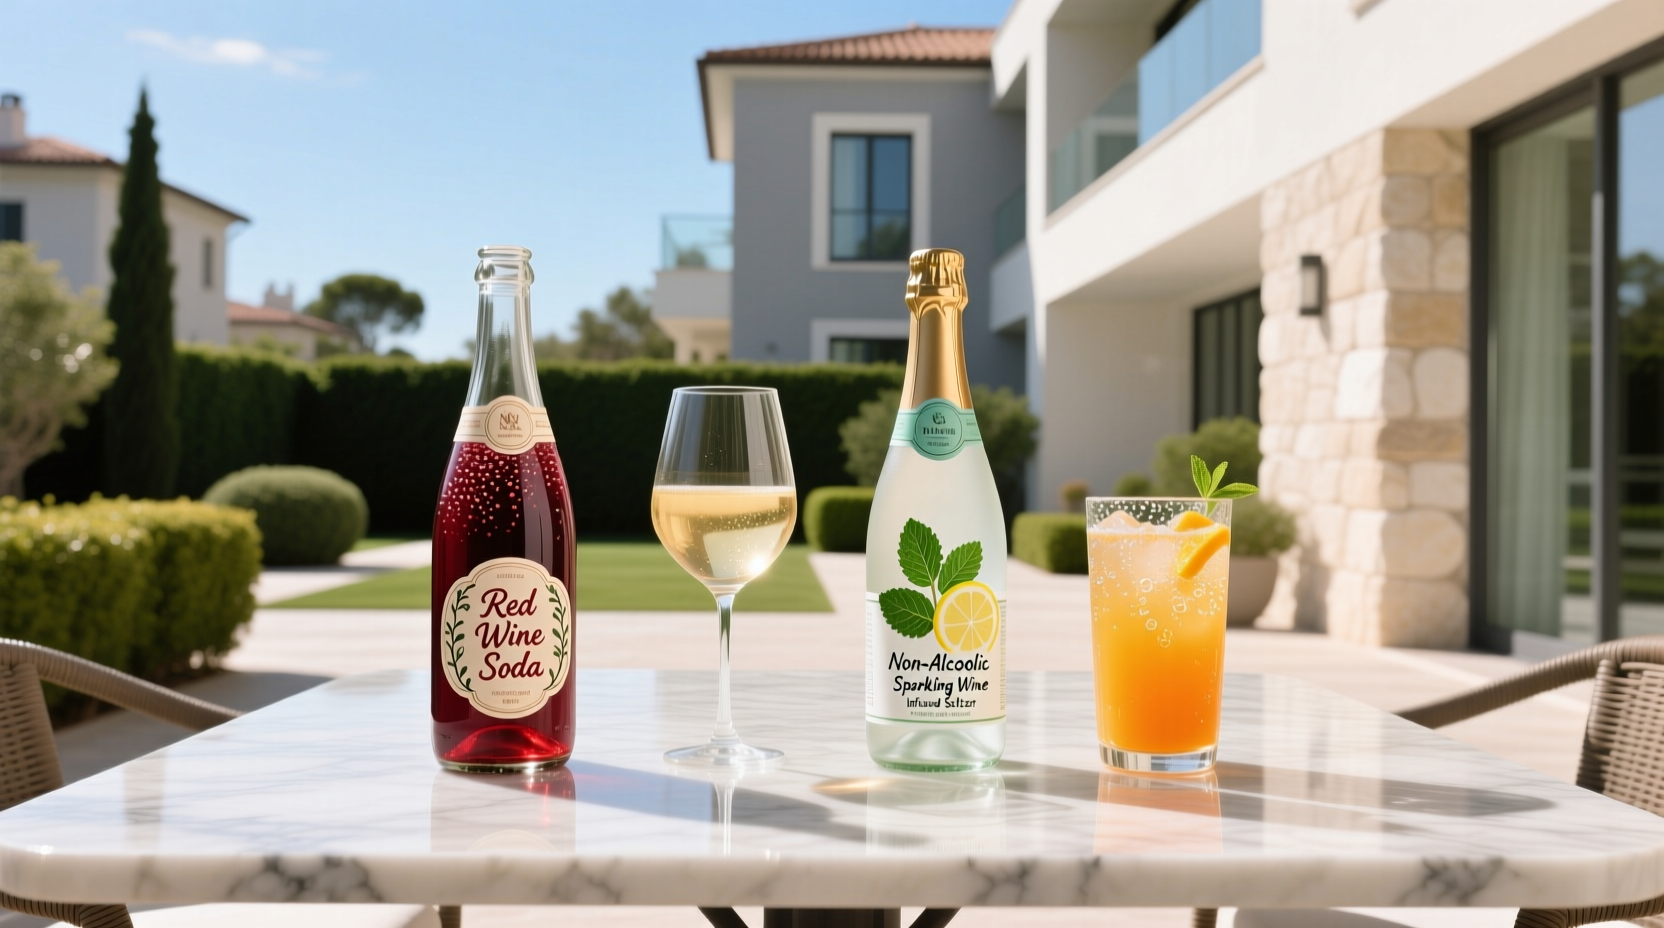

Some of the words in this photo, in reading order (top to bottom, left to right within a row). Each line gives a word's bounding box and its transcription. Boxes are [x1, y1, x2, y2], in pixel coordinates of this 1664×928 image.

[479, 587, 538, 618] Red
[474, 620, 545, 649] Wine
[478, 650, 544, 681] Soda
[888, 651, 990, 671] Non-Alcoolic
[957, 676, 989, 692] Wine
